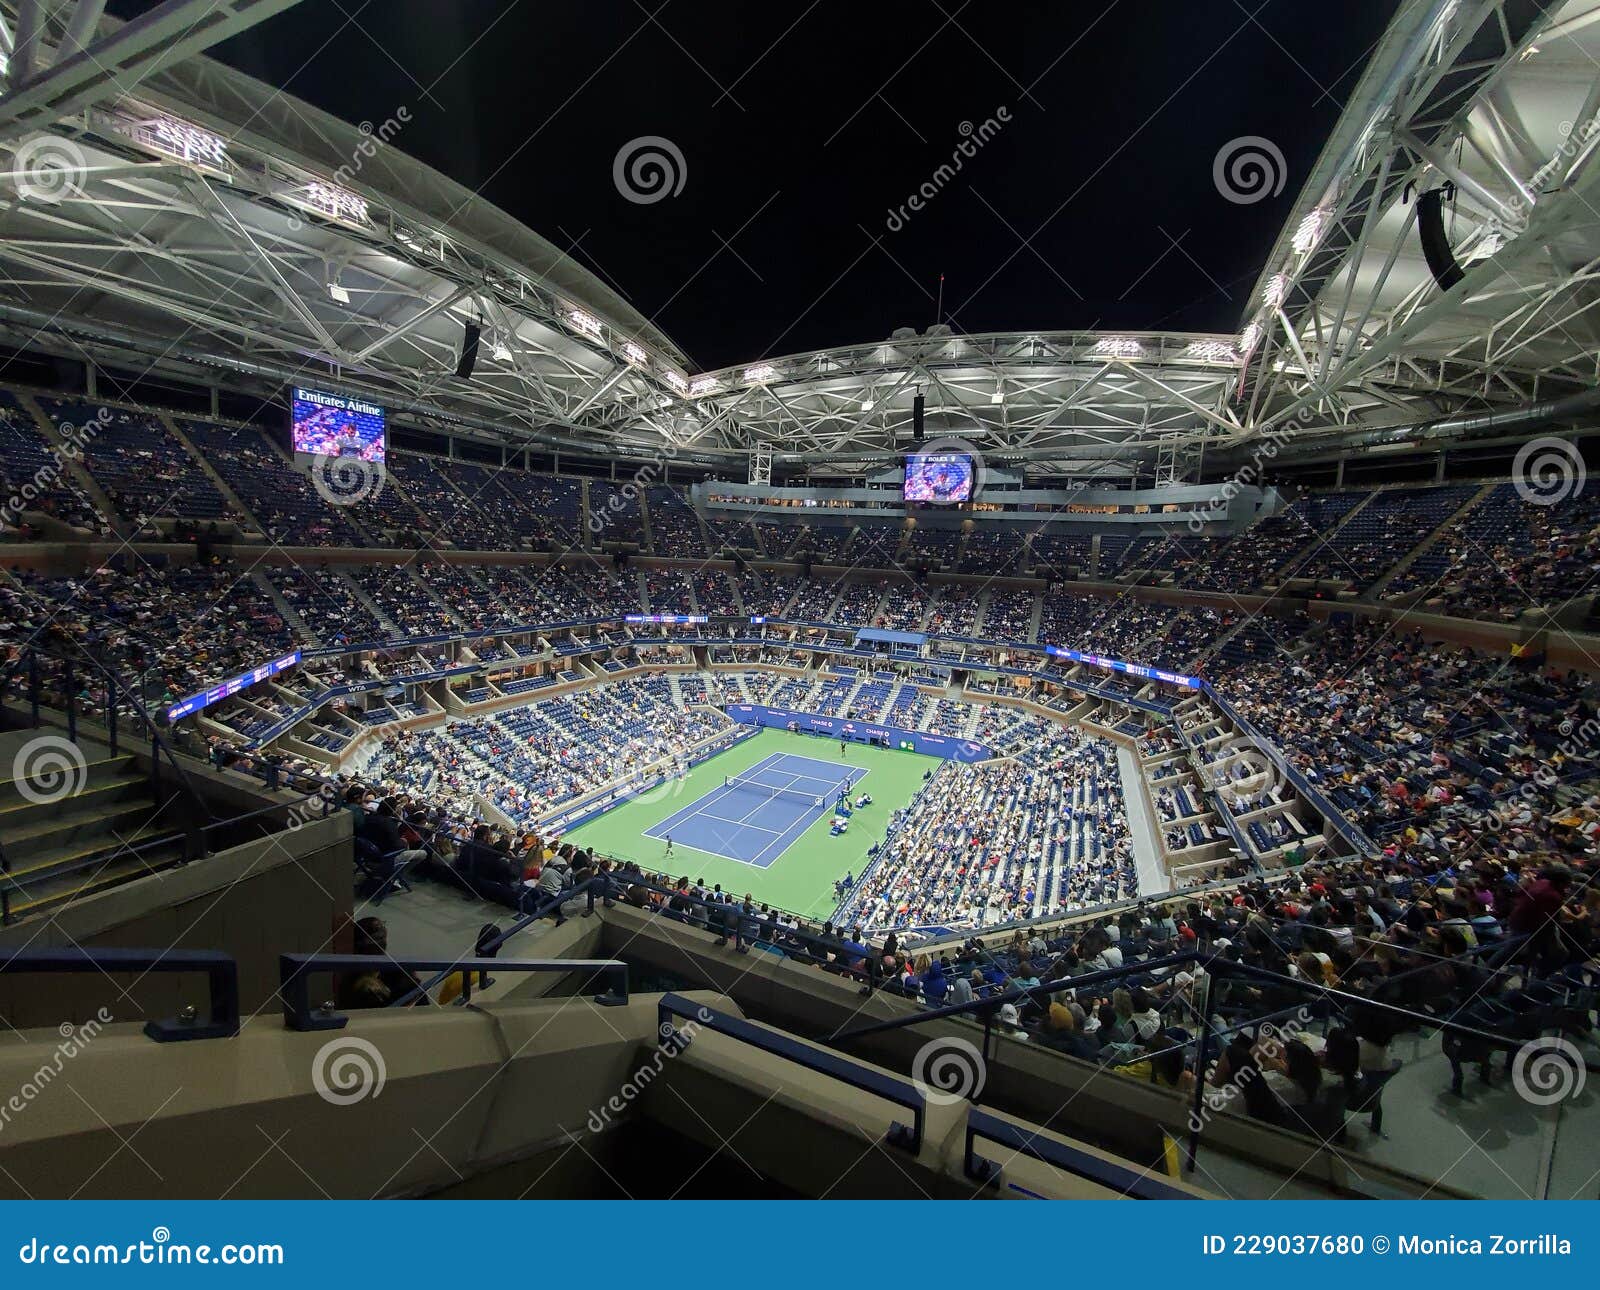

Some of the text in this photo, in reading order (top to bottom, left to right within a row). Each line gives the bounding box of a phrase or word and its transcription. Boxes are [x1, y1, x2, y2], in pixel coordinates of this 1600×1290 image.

[299, 390, 381, 416] Emirates Airline
[811, 719, 828, 727] CHASE
[866, 728, 884, 736] CHASE
